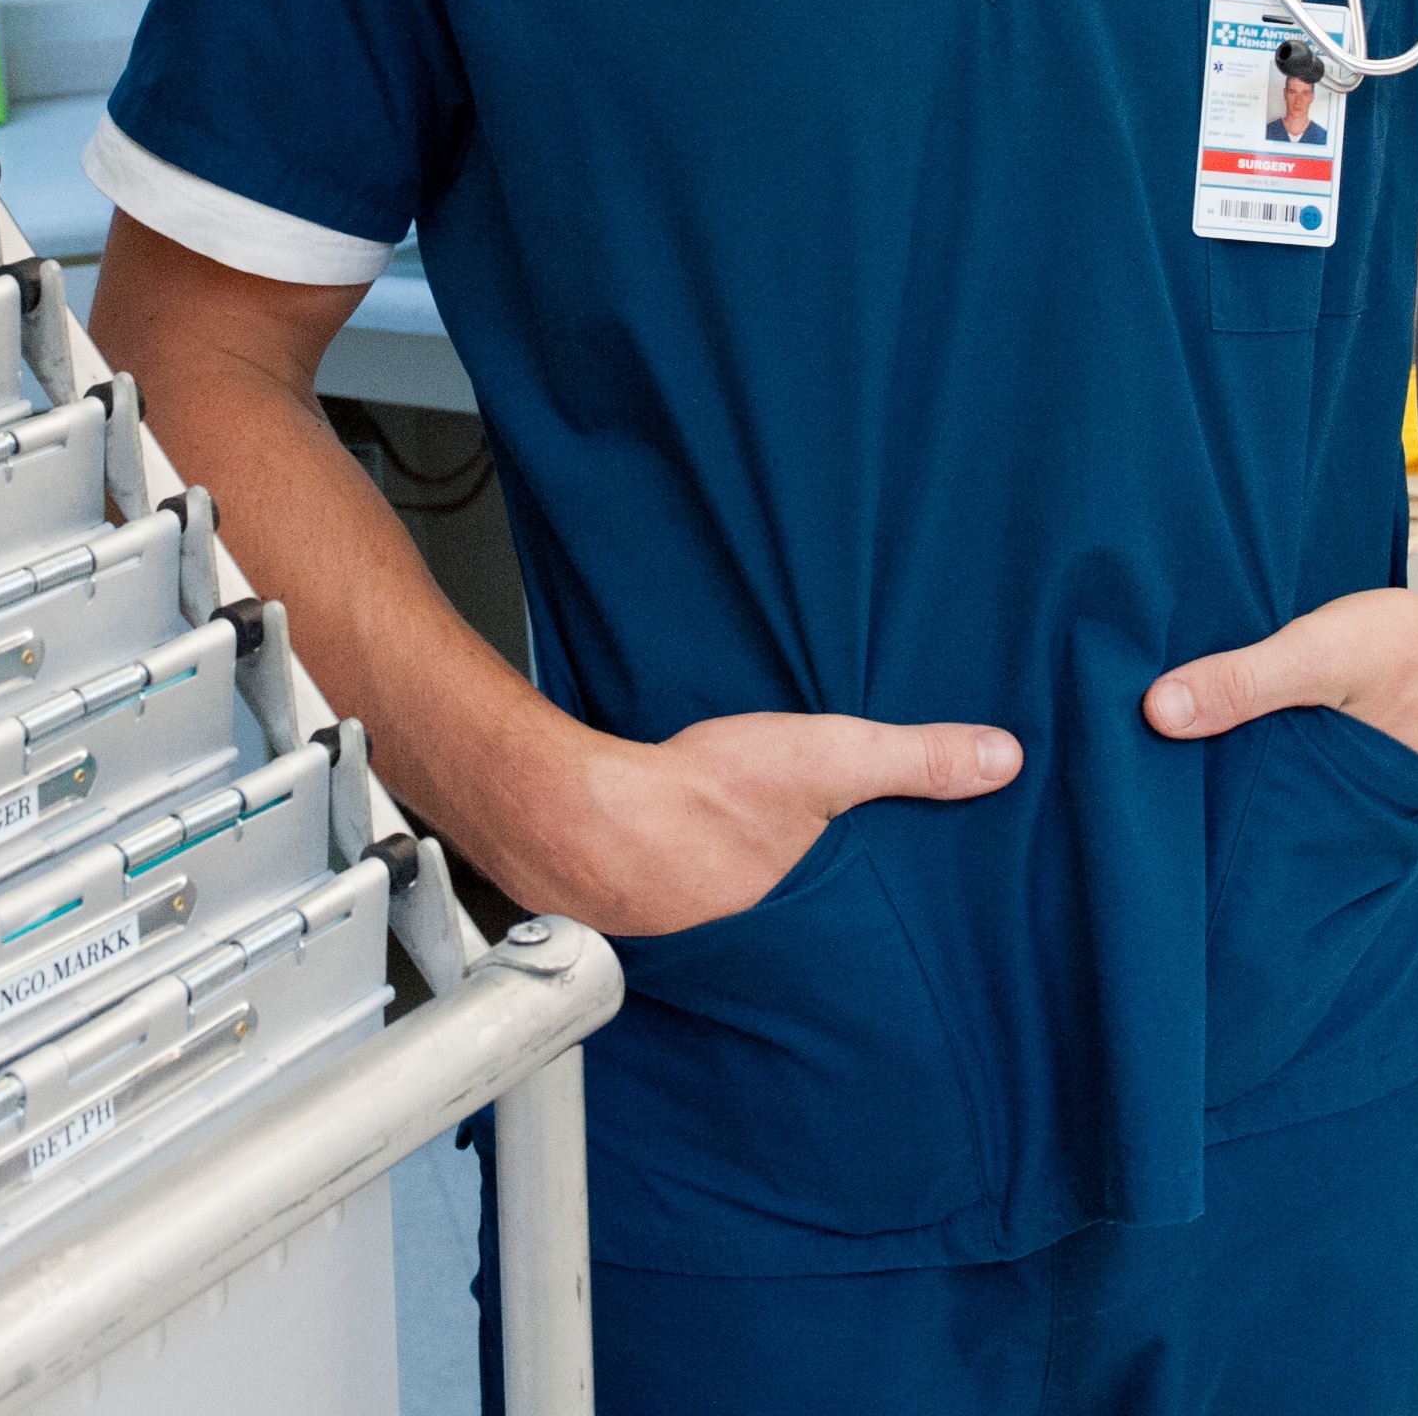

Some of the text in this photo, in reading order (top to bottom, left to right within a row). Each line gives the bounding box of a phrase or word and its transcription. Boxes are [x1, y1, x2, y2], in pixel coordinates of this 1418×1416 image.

[1238, 26, 1258, 37] SAN
[1237, 37, 1281, 49] MEMORI
[1237, 158, 1296, 173] SURGERY
